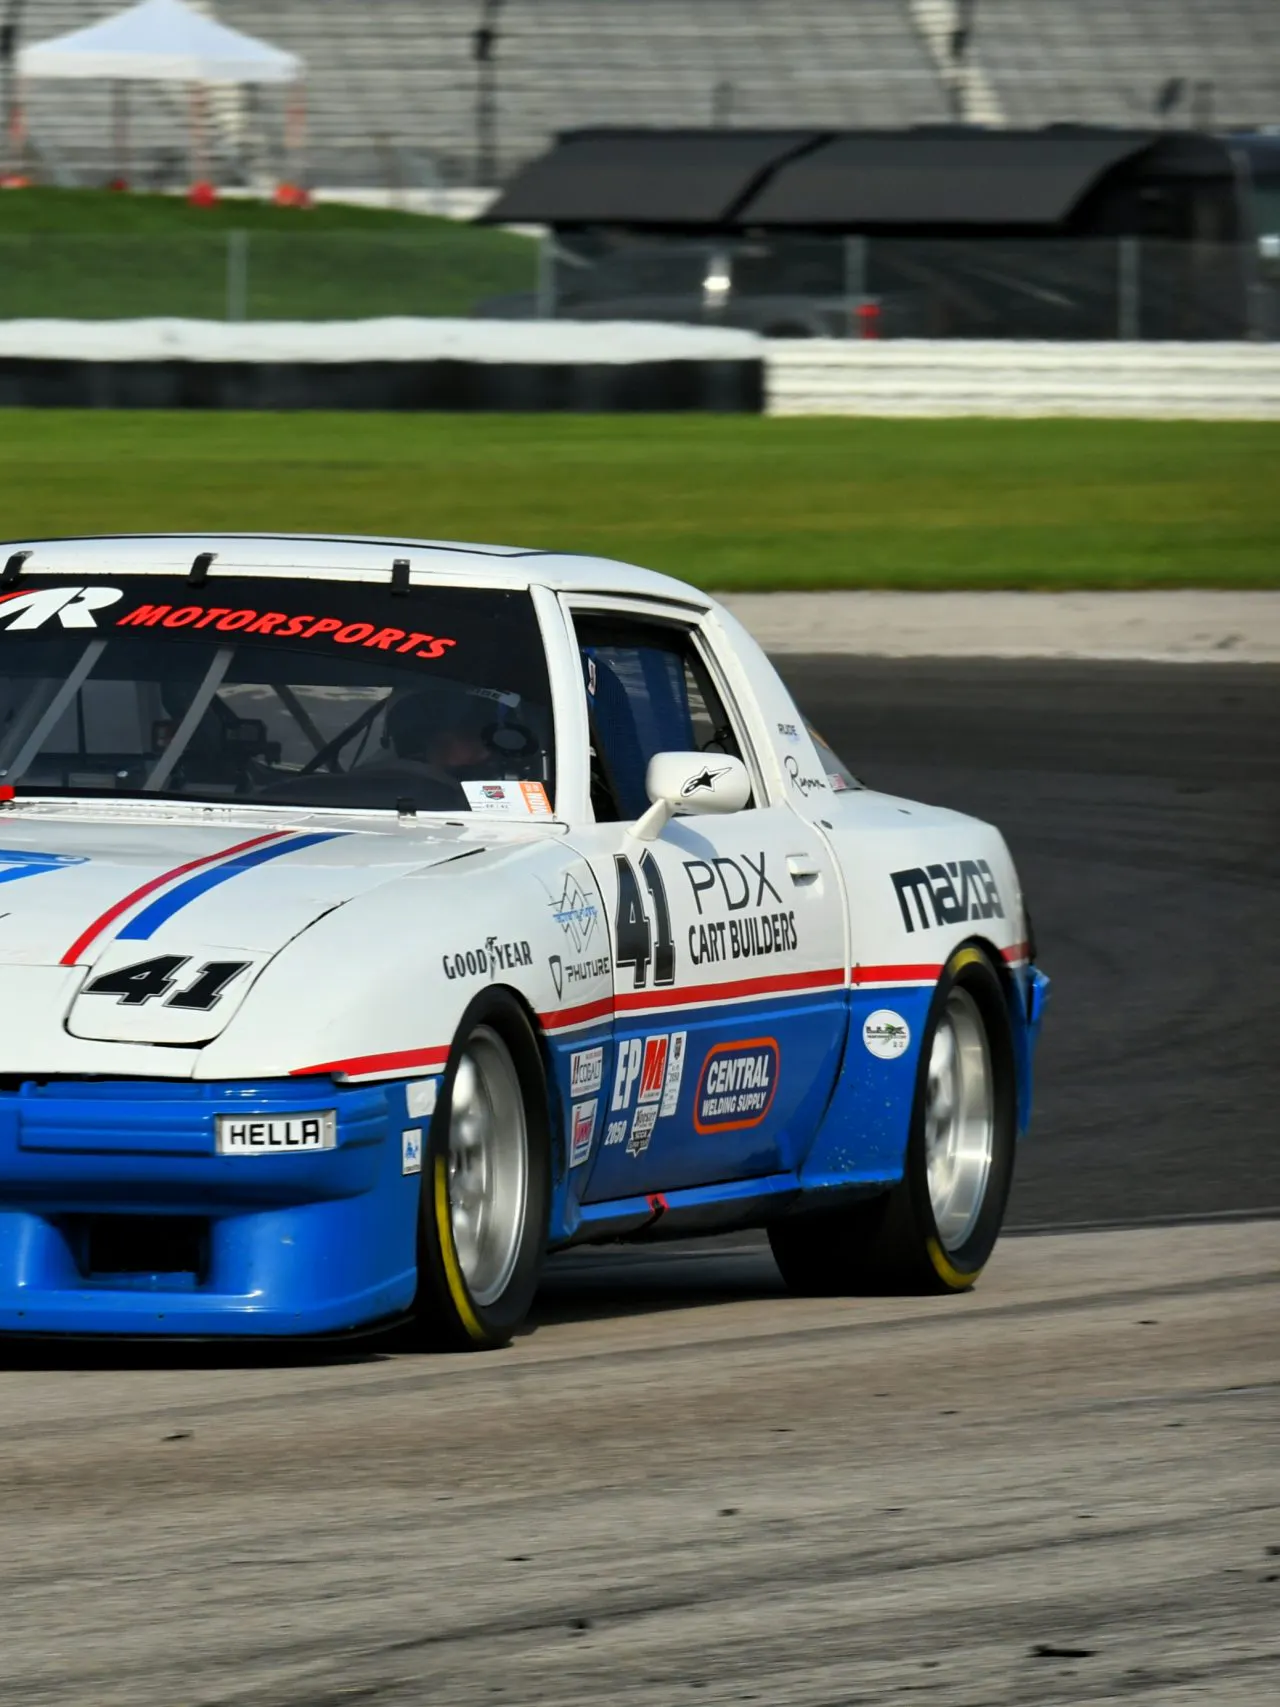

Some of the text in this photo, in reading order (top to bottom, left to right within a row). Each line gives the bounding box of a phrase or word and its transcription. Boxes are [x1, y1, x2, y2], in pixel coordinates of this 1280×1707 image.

[117, 604, 456, 659] MOTORSPORTS
[682, 852, 783, 915] PDX
[613, 847, 676, 989] 41
[688, 911, 798, 965] CART BUILDERS
[81, 953, 254, 1012] 41
[611, 1038, 642, 1111] EP
[707, 1054, 769, 1095] CENTRAL
[702, 1092, 767, 1117] WELDING SUPPLY
[230, 1118, 320, 1147] HELLA
[604, 1120, 627, 1146] 2050
